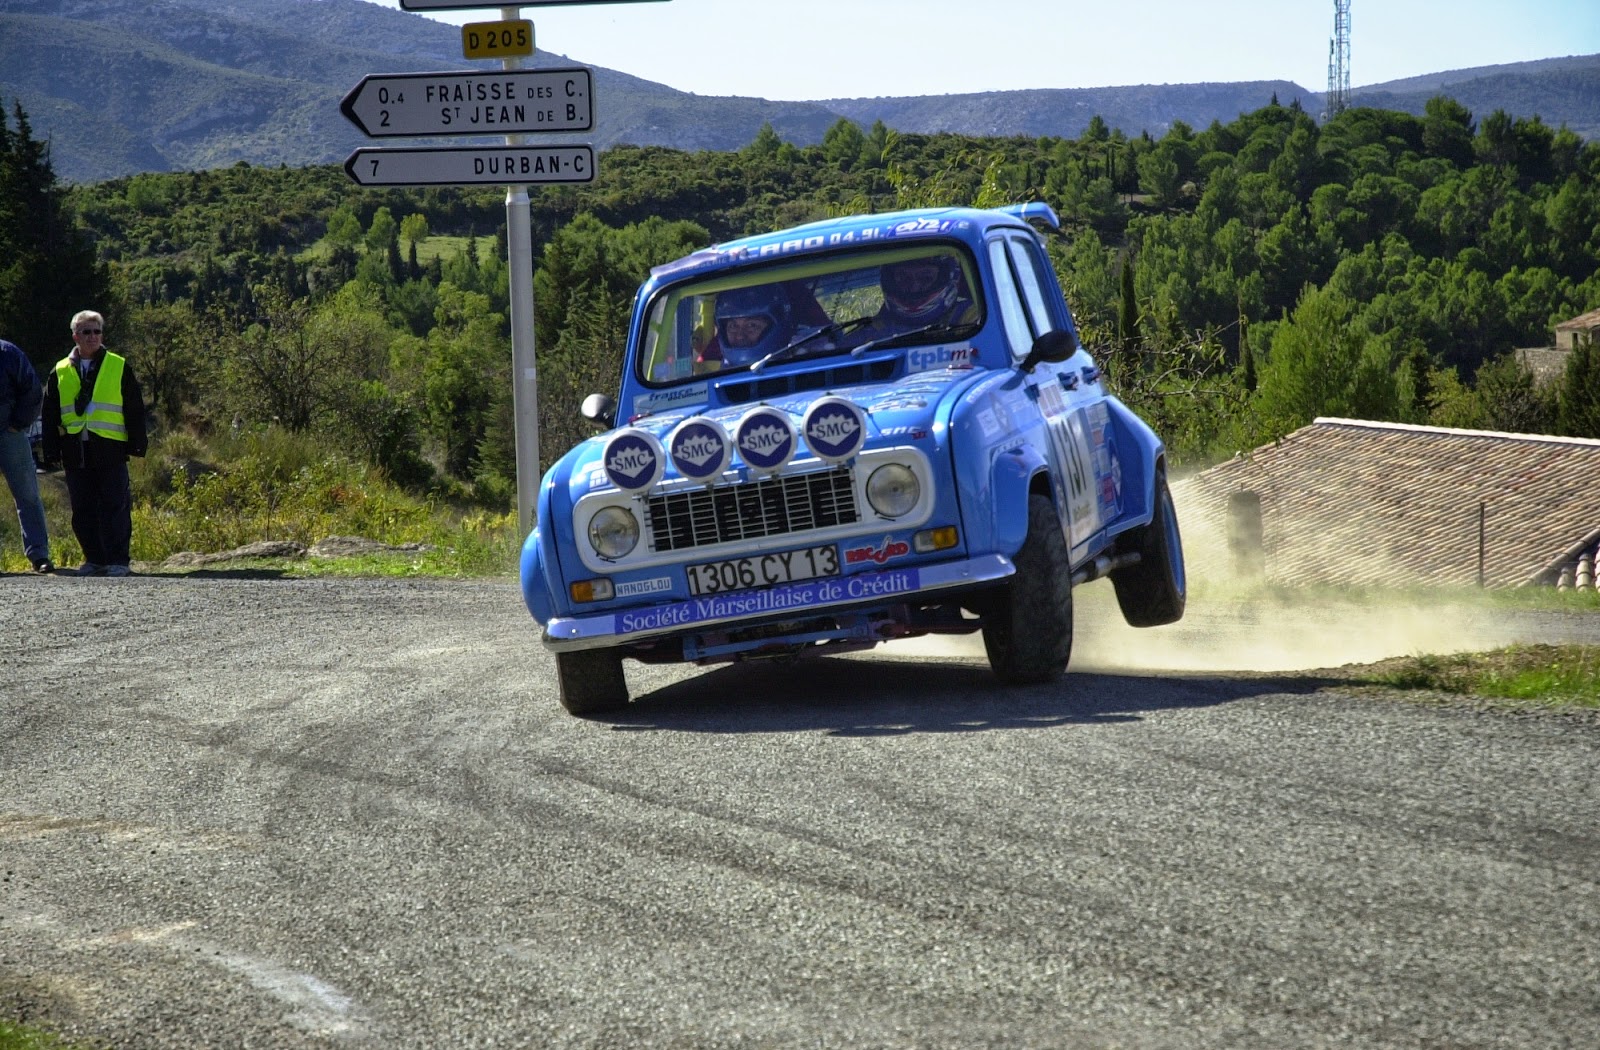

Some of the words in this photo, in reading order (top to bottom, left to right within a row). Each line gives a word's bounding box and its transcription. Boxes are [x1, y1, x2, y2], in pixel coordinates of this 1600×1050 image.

[468, 32, 480, 50] D
[486, 29, 527, 49] 205
[426, 80, 516, 103] FRAÏSSE
[527, 87, 553, 99] DES
[565, 79, 583, 98] C.
[379, 110, 391, 127] 2
[470, 105, 526, 124] JEAN
[537, 110, 554, 123] DE
[566, 103, 584, 122] B.
[370, 160, 380, 177] 7
[474, 155, 584, 175] DURBAN-C
[909, 346, 968, 370] tpbm
[747, 431, 782, 450] SMC
[815, 421, 851, 439] SMC
[681, 441, 715, 460] SMC
[614, 453, 648, 472] SMC
[688, 558, 756, 596] 1306
[760, 551, 794, 585] CY
[804, 546, 838, 577] 13
[622, 604, 690, 633] Société
[695, 585, 814, 621] Marseillaise
[818, 582, 842, 601] de
[847, 574, 910, 597] Crédit
